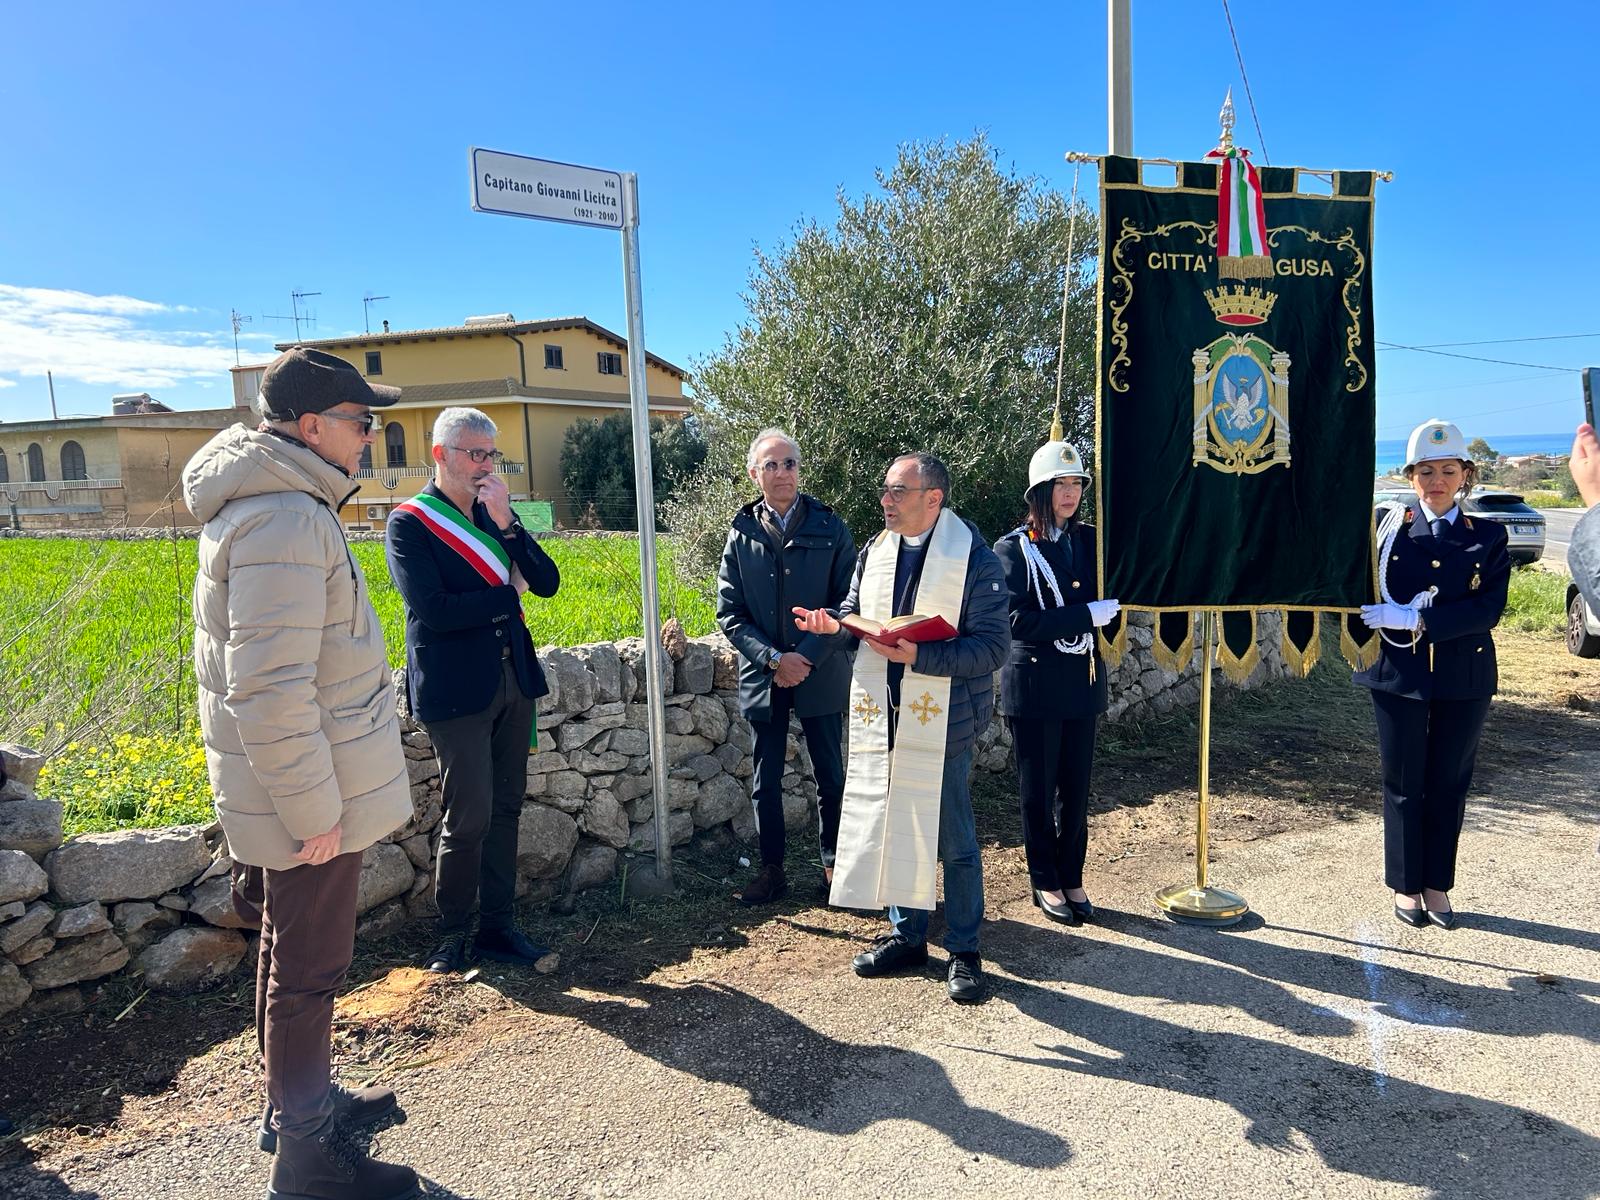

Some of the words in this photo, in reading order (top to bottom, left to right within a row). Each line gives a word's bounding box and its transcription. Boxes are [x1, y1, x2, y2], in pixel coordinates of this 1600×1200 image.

[485, 173, 533, 193] Capitano
[537, 182, 580, 201] Giovanni
[584, 189, 616, 206] Licitra
[605, 179, 615, 188] via
[1148, 252, 1213, 273] CITTA'
[1274, 258, 1334, 277] GUSA
